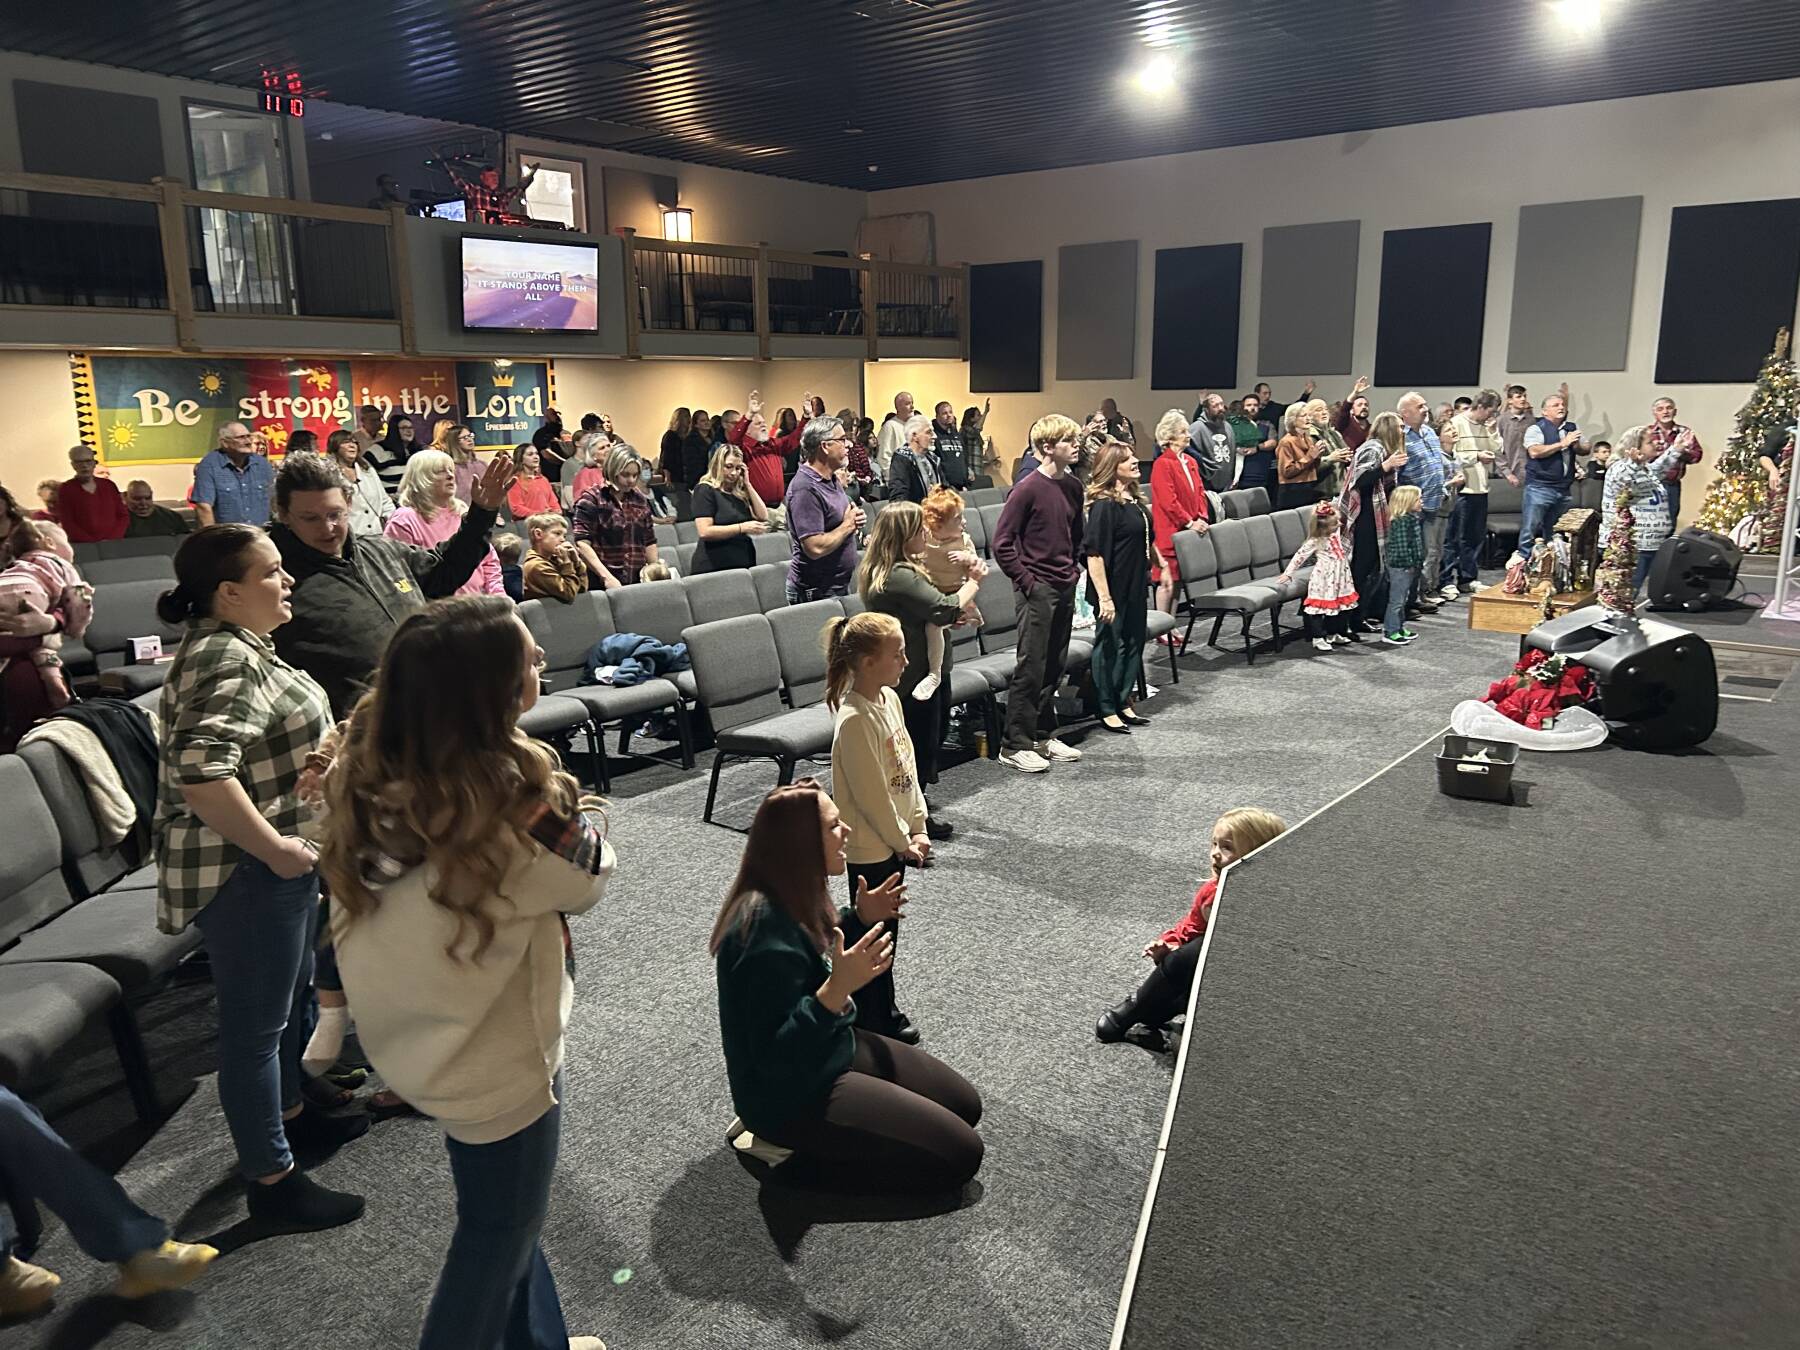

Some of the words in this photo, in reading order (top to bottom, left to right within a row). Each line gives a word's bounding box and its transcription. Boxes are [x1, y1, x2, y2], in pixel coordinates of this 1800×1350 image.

[506, 271, 532, 280] YOUR
[534, 272, 561, 281] NAME
[478, 280, 488, 288] IT
[490, 280, 528, 290] STANDS
[529, 282, 561, 292] ABOVE
[563, 284, 587, 293] THEM
[524, 292, 543, 301] ALL
[132, 388, 202, 427] Be
[238, 390, 353, 425] strong
[360, 387, 393, 422] in
[400, 387, 451, 421] the
[464, 386, 545, 419] Lord
